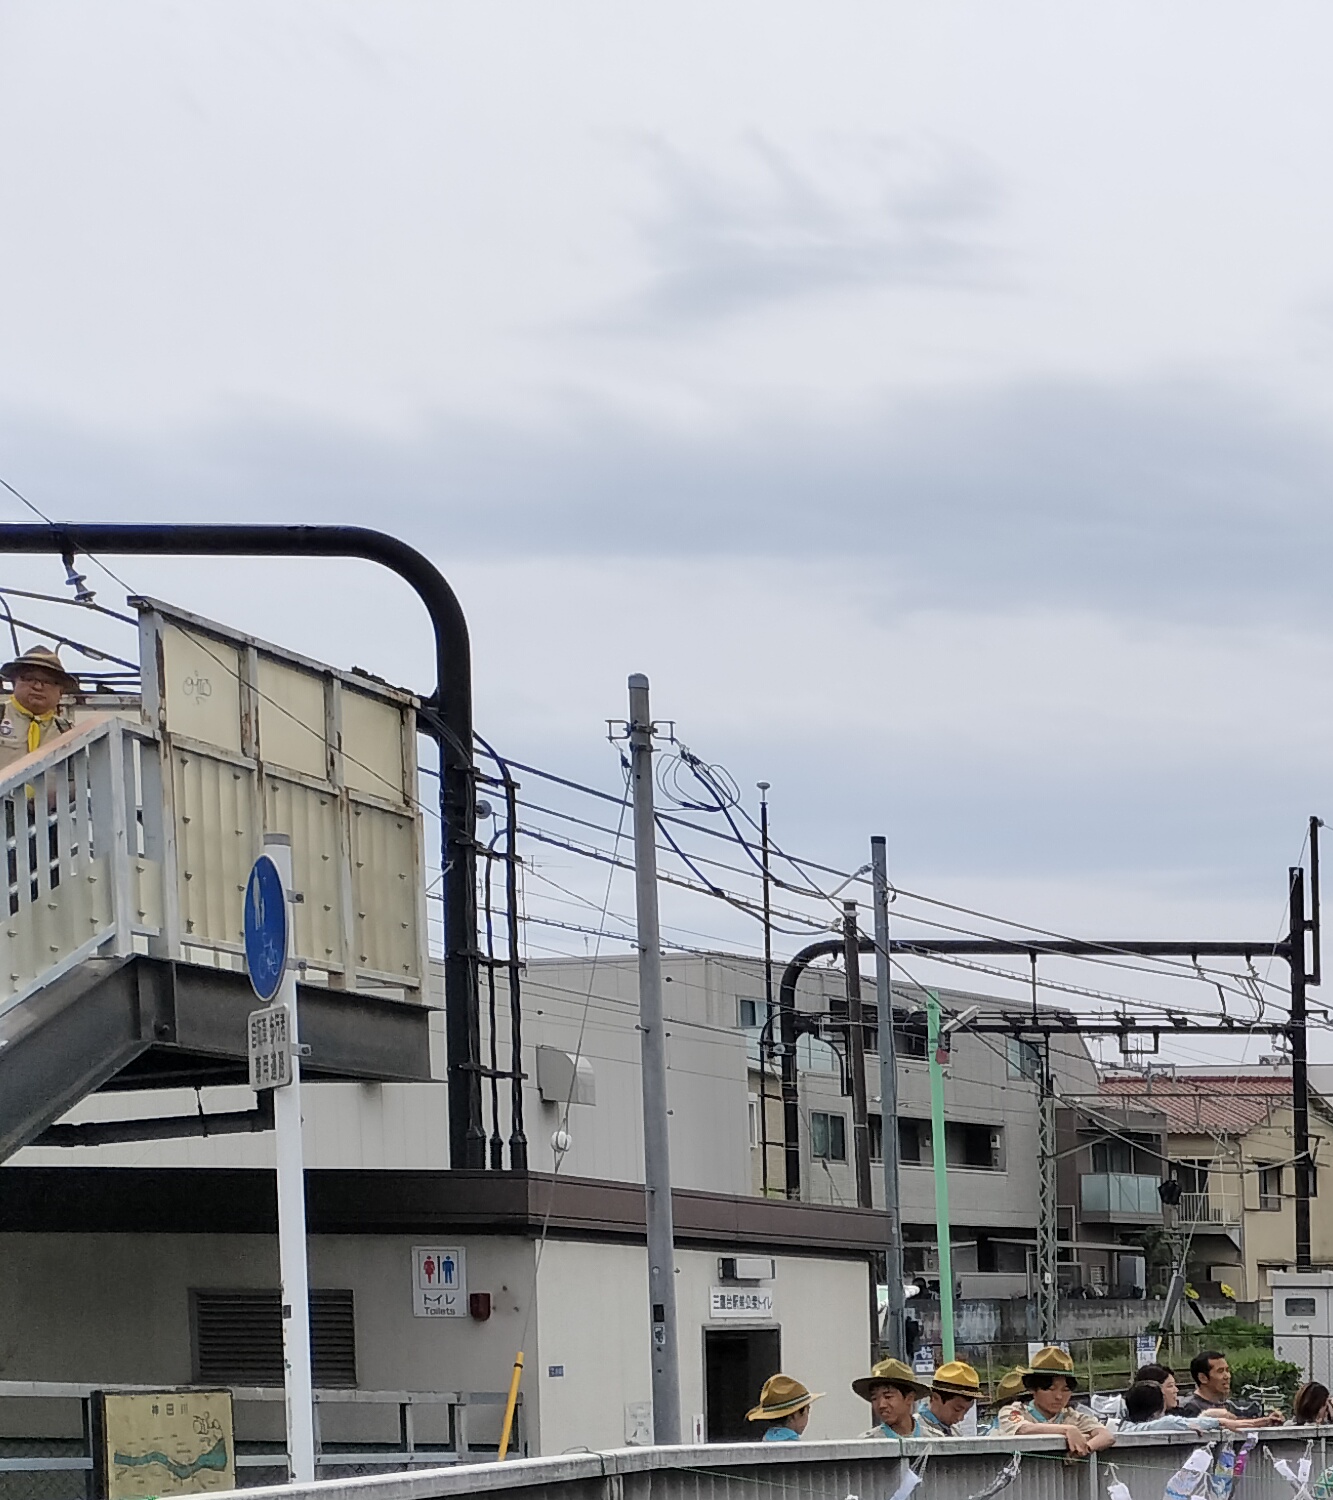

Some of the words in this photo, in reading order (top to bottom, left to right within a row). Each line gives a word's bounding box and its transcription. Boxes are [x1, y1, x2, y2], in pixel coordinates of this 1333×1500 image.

[424, 1293, 455, 1305] トイレ
[424, 1306, 455, 1316] Toilets
